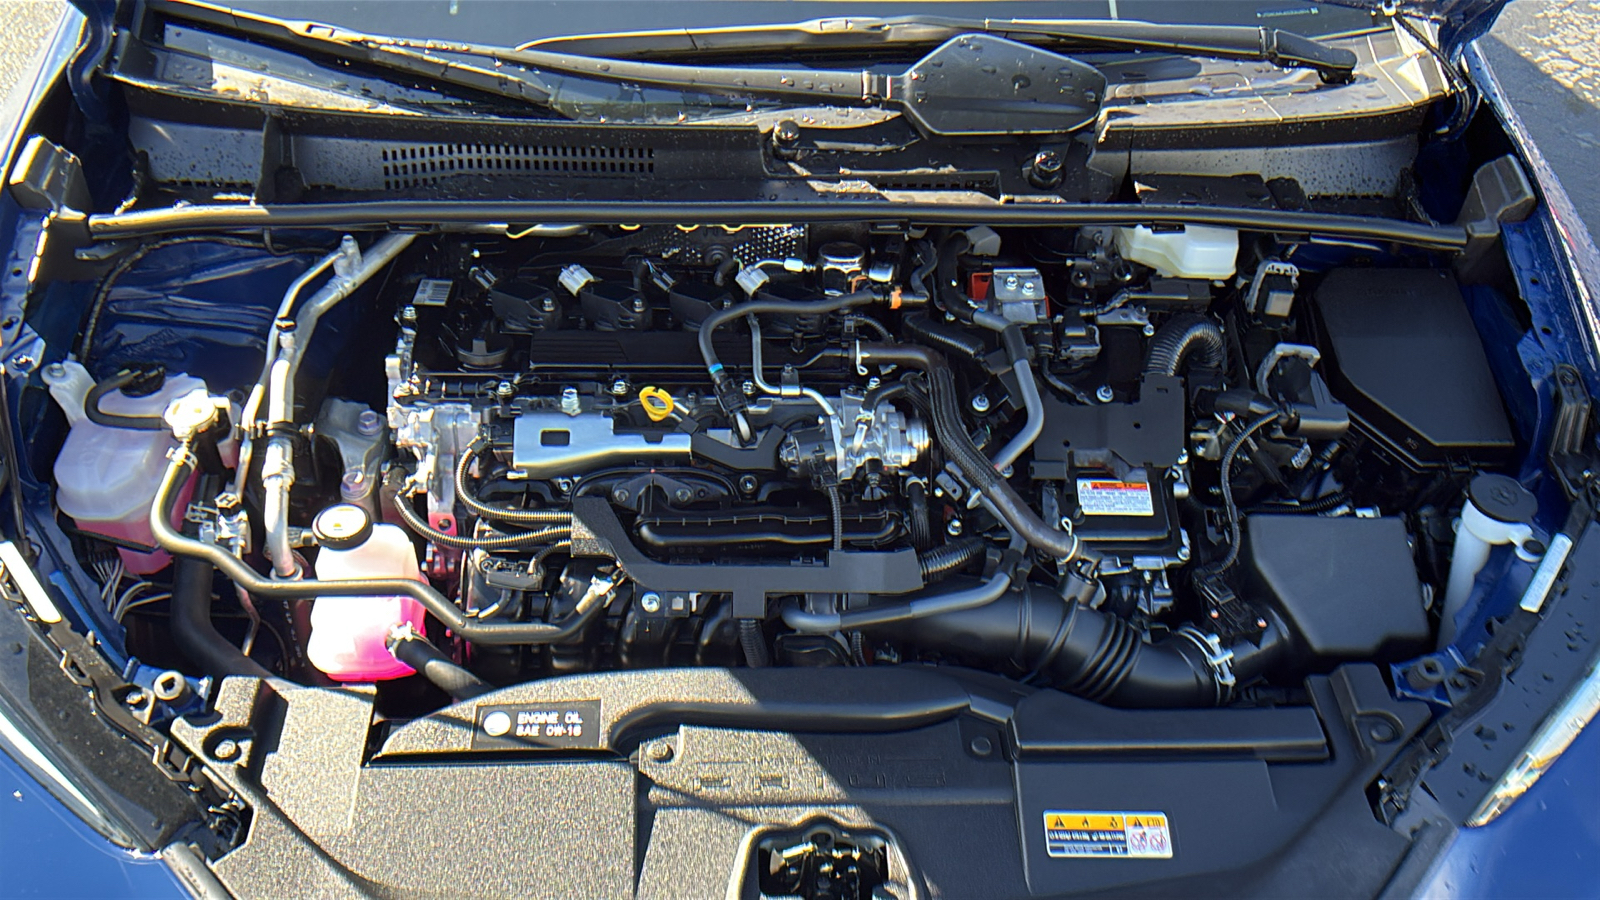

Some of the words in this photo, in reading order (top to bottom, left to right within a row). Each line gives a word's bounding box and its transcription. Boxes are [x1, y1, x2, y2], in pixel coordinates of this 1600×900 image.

[517, 711, 560, 724] ENGINE
[564, 710, 583, 724] OIL
[515, 723, 540, 737] SAE
